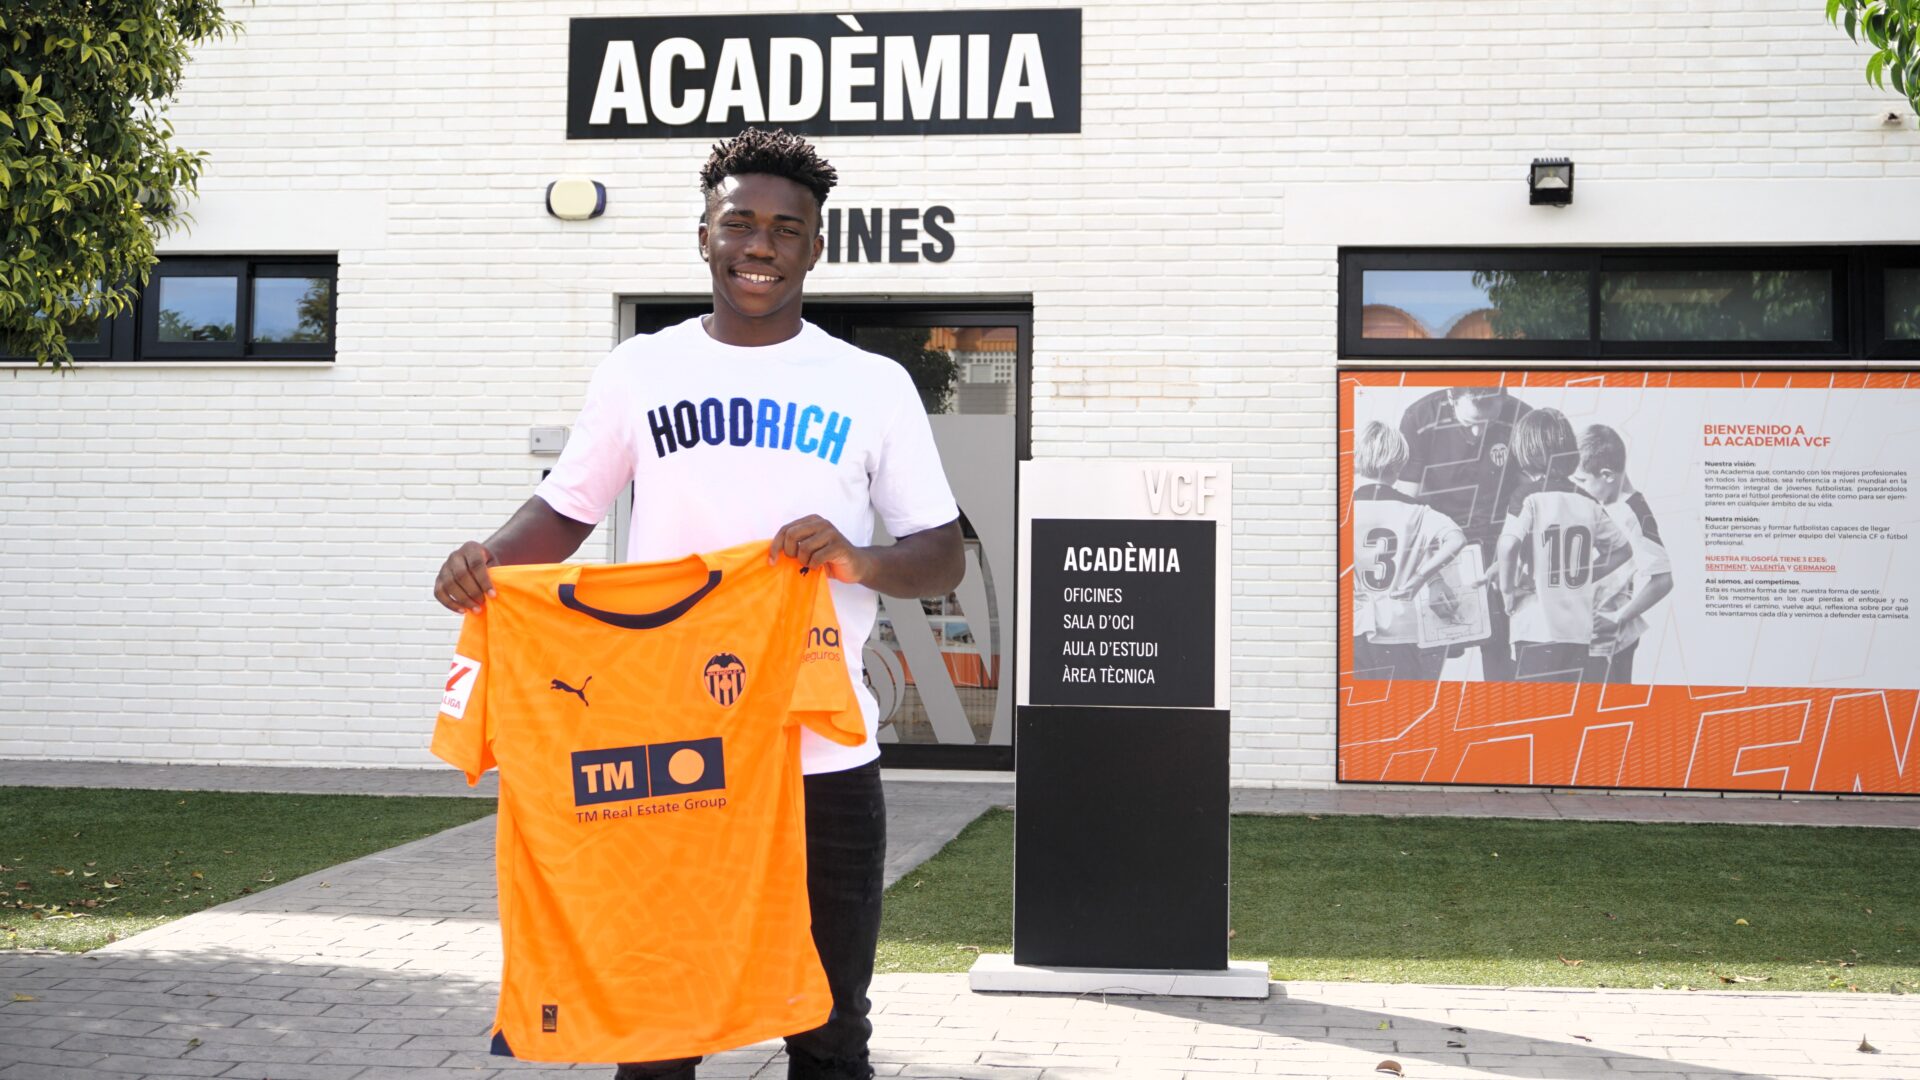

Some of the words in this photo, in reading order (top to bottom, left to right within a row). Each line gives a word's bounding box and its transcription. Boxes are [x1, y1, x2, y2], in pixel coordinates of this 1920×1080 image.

[589, 14, 1055, 126] ACADÈMIA
[647, 397, 852, 465] HOODRICH
[1704, 425, 1792, 436] BIENVENIDO
[1795, 426, 1805, 436] A
[1704, 437, 1721, 447] LA
[1725, 437, 1800, 447] ACADEMIA
[1804, 437, 1831, 447] VCF
[1143, 468, 1217, 515] VCF
[1063, 541, 1181, 573] ACADÈMIA
[1362, 527, 1398, 592] 3
[1541, 524, 1592, 589] 10
[1750, 564, 1786, 573] VALENTÍA
[1064, 588, 1123, 603] OFICINES
[1063, 614, 1095, 630] SALA
[1062, 641, 1096, 656] AULA
[1062, 664, 1096, 683] ÀREA
[1100, 665, 1155, 684] TÈCNICA
[581, 759, 635, 795] TM
[576, 810, 599, 823] TM
[602, 805, 634, 821] Real
[637, 801, 680, 817] Estate
[684, 795, 727, 813] Group
